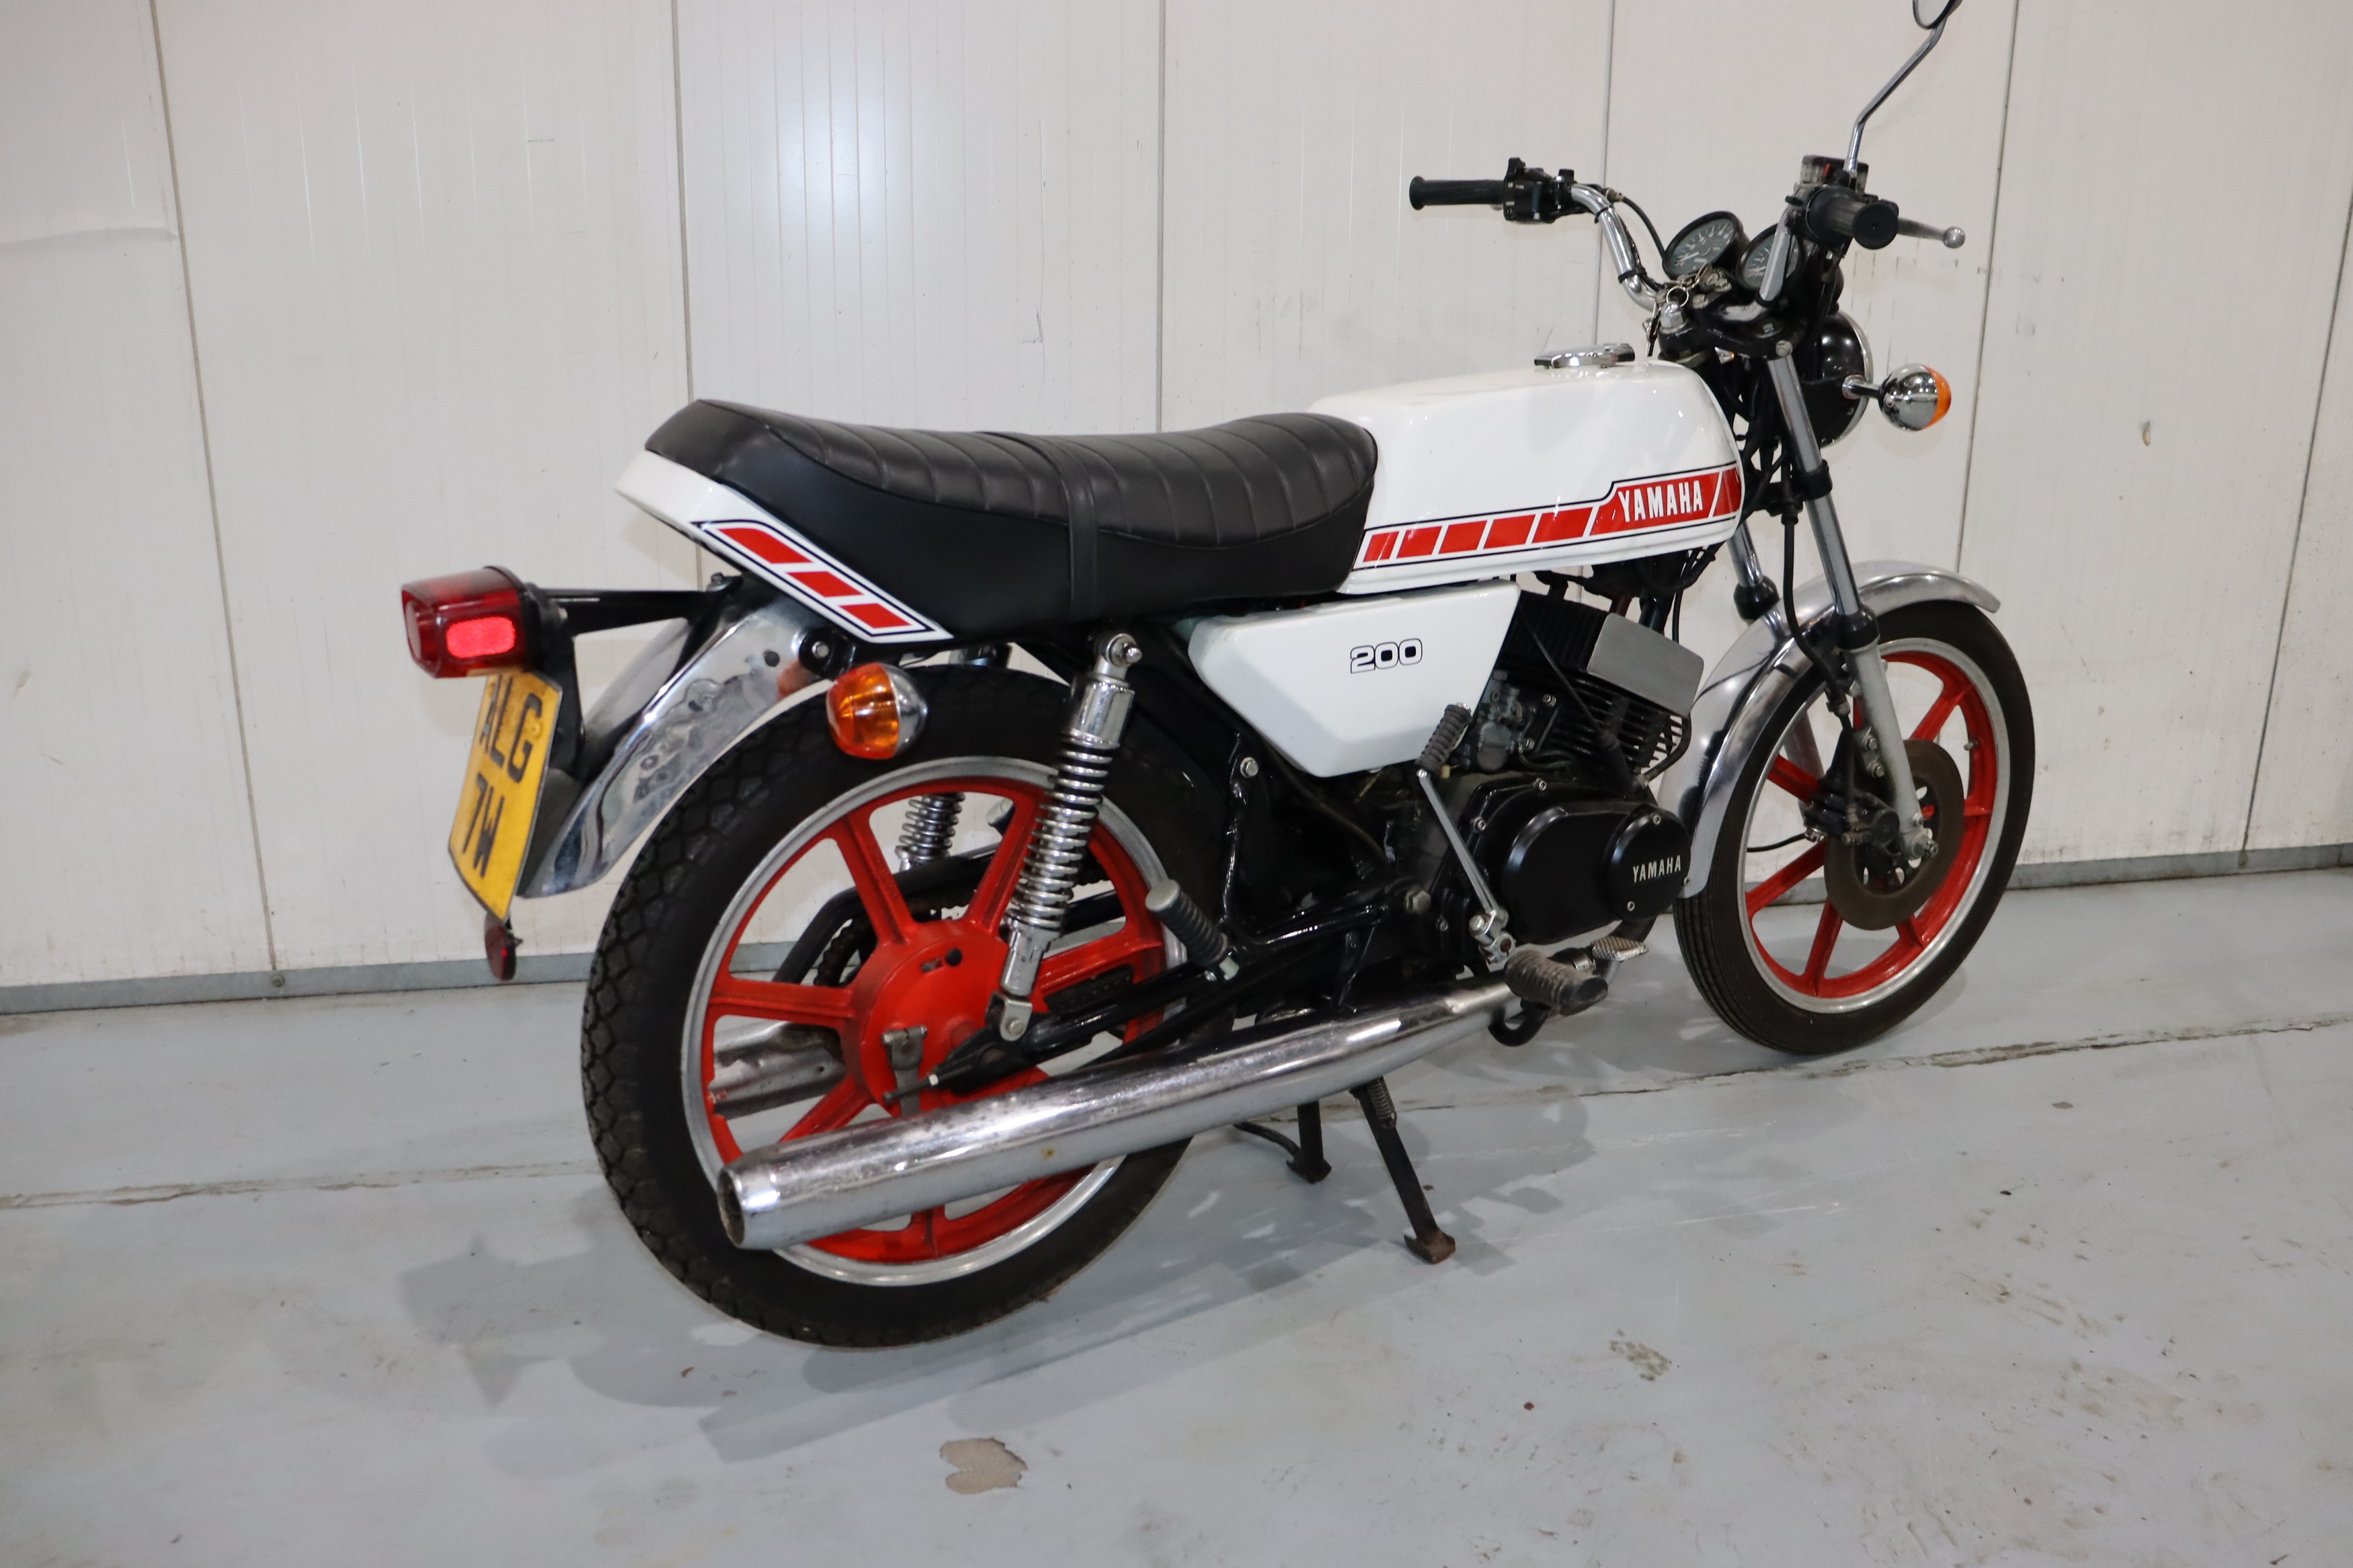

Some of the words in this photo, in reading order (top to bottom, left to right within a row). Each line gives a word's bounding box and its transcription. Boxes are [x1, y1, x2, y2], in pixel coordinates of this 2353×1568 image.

[1618, 480, 1704, 523] YAMAHA
[1350, 638, 1423, 674] 200
[463, 772, 505, 879] 7W
[1632, 855, 1681, 883] YAMAHA
